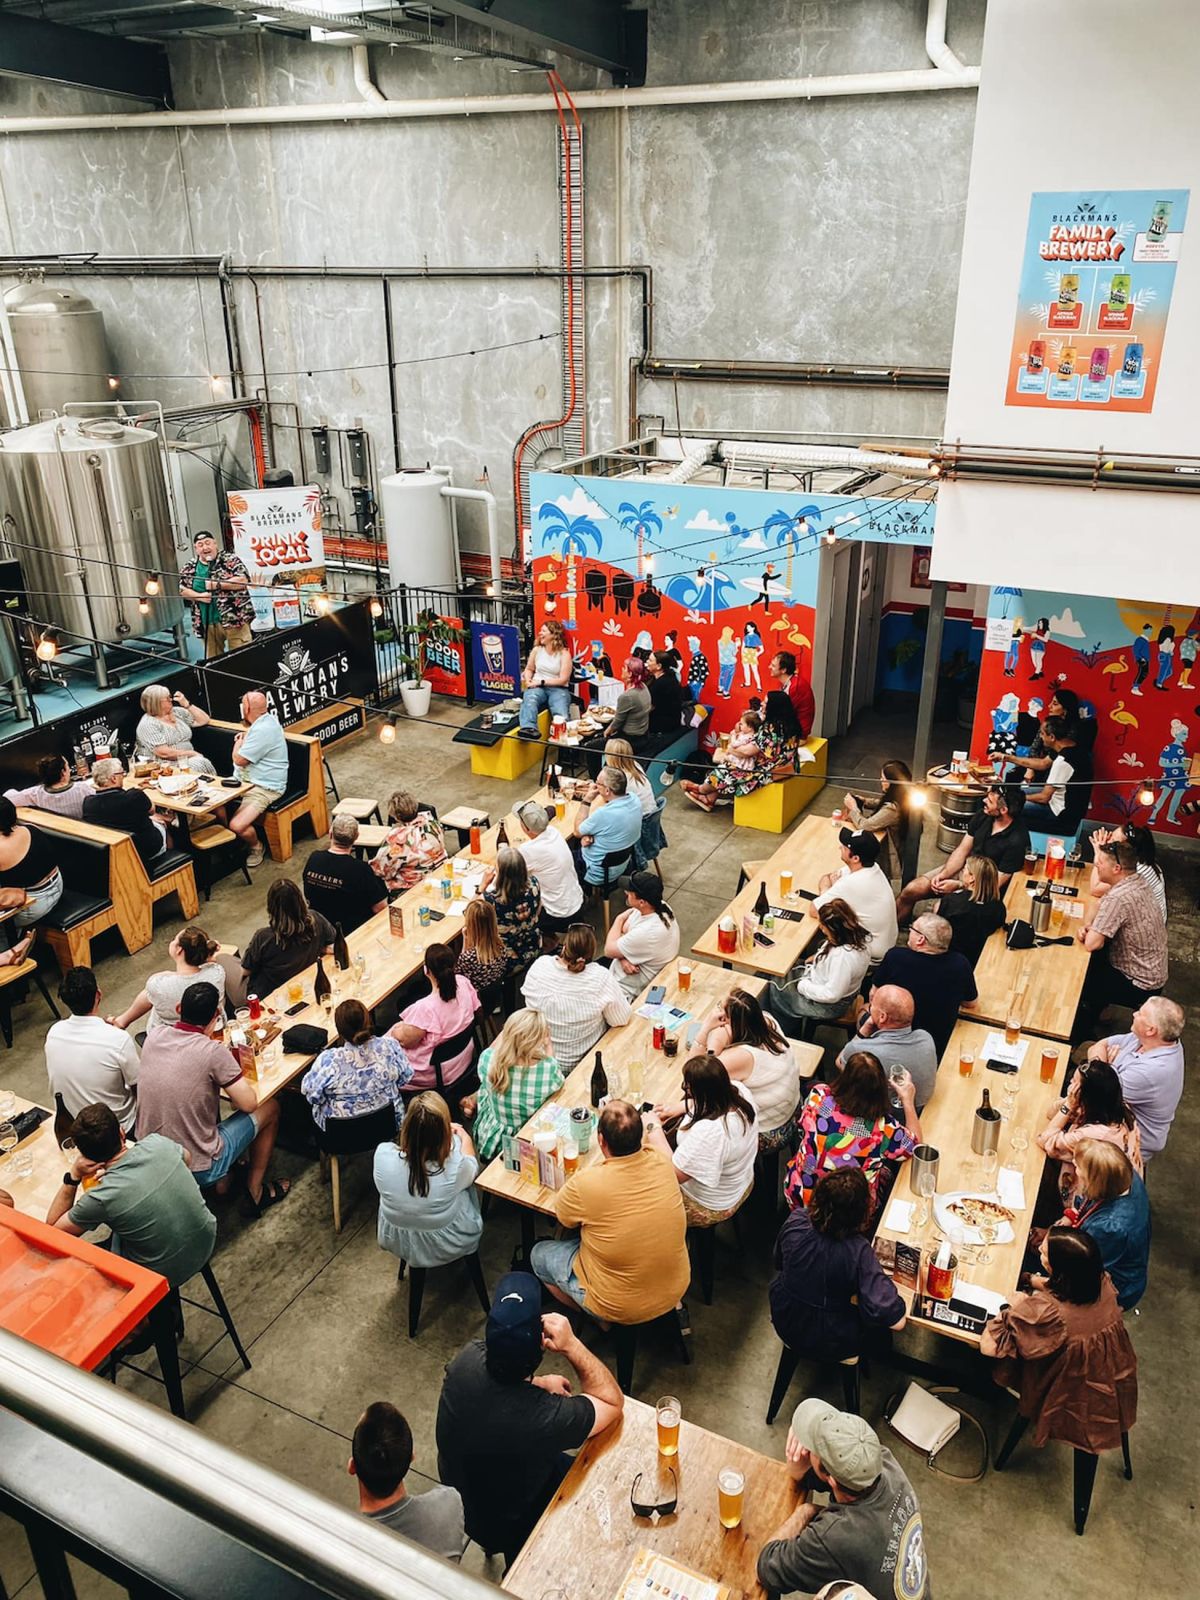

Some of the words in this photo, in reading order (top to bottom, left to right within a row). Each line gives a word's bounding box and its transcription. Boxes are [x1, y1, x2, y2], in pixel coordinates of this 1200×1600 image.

[1052, 214, 1118, 222] BLACKMANS
[1049, 225, 1116, 242] FAMILY
[1039, 240, 1125, 261] BREWERY
[250, 512, 302, 521] BLACKMANS
[249, 531, 309, 551] DRINK
[255, 545, 312, 567] LOCAL
[426, 647, 461, 673] BEER
[486, 681, 514, 690] LAGERS
[339, 712, 359, 731] BEER
